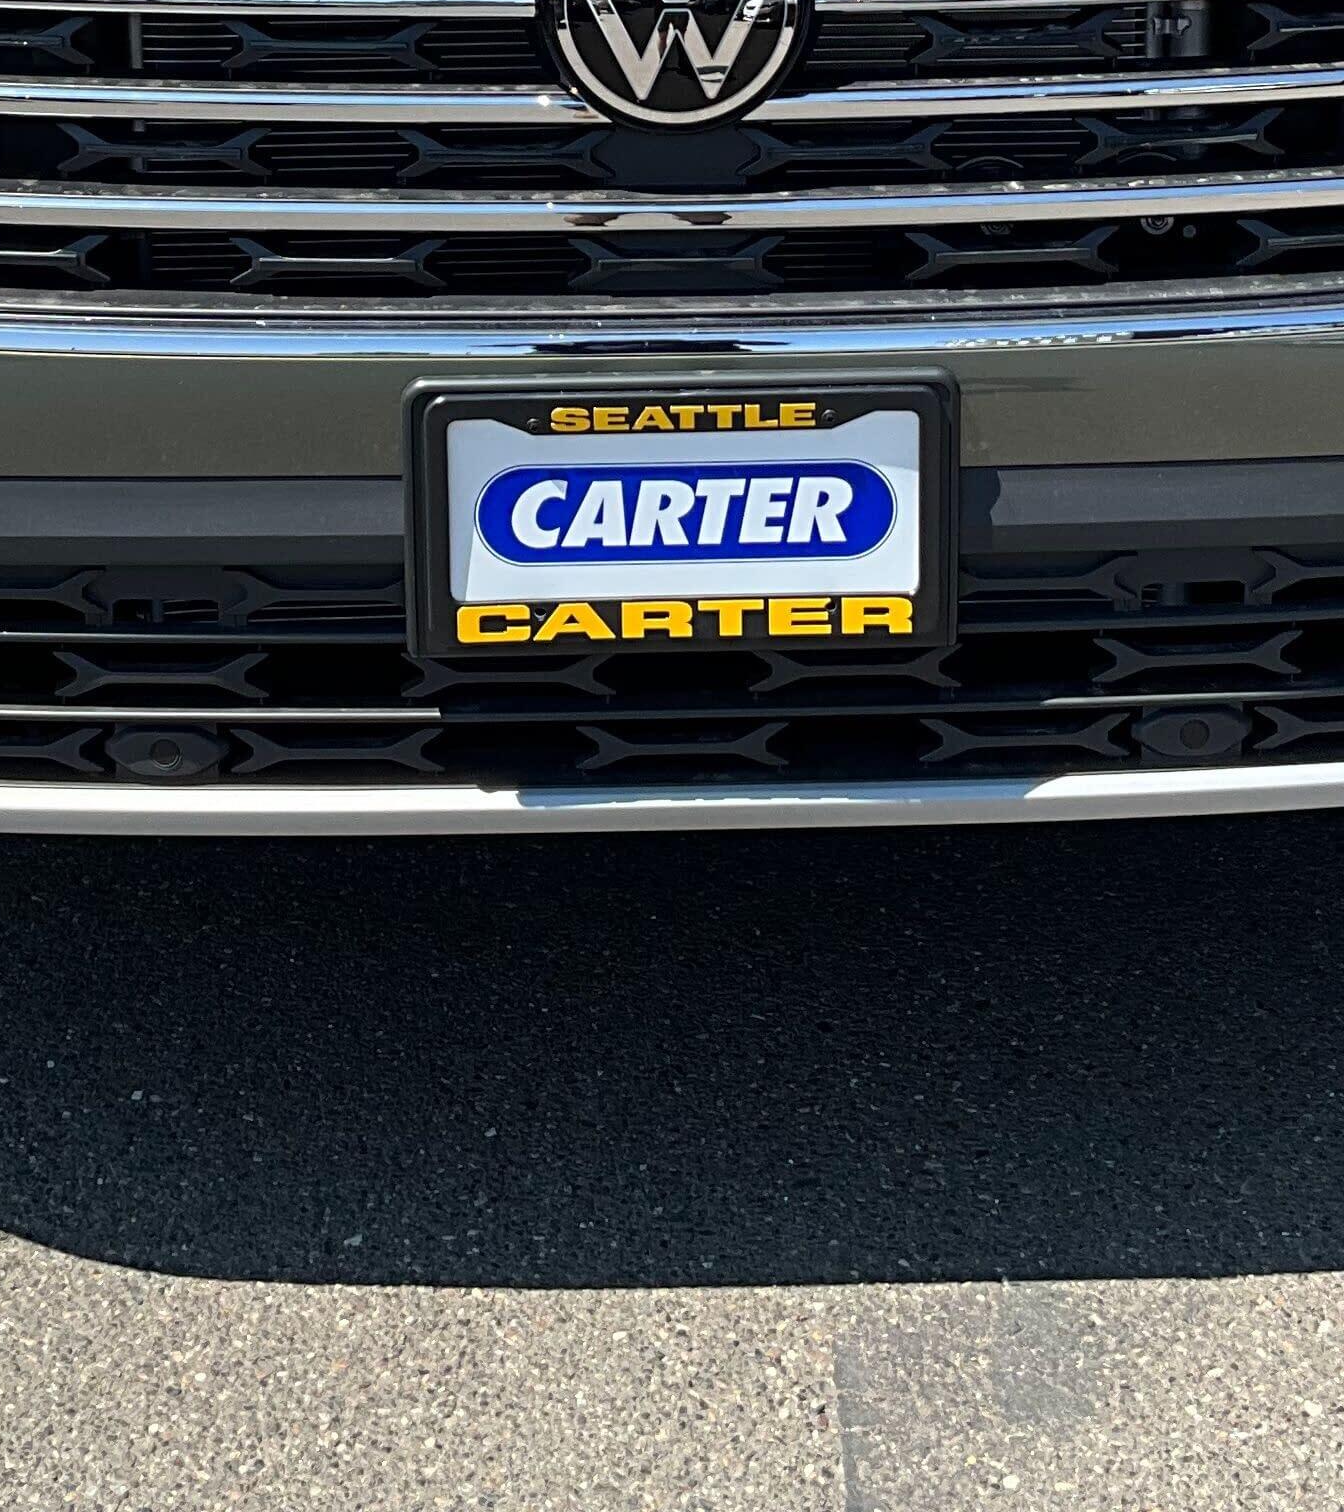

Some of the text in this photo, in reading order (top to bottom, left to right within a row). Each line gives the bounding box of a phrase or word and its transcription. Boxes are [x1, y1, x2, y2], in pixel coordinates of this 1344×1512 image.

[550, 402, 817, 432] SEATTLE
[511, 476, 853, 549] CARTER
[456, 596, 913, 644] CARTER
